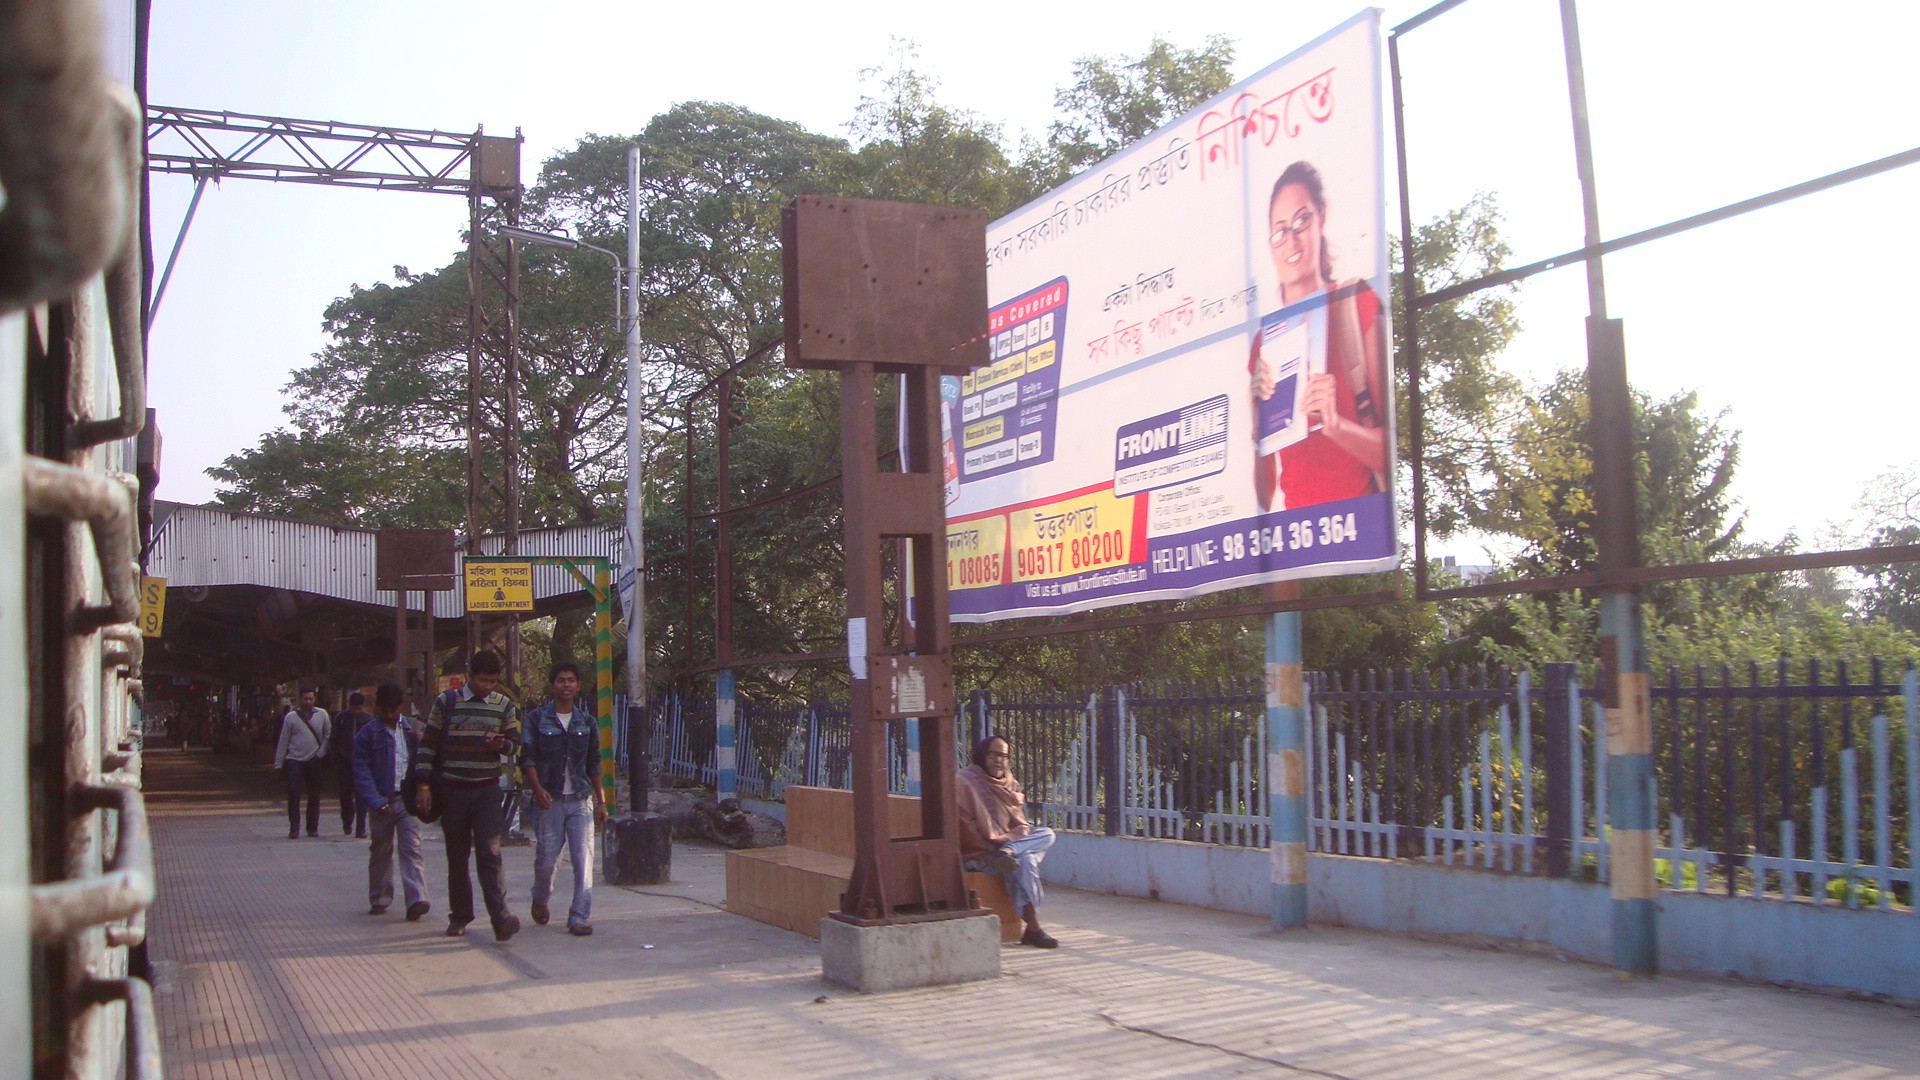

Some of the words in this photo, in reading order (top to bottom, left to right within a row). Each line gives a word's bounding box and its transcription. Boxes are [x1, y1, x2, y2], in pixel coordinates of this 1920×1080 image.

[1017, 200, 1069, 253] সরকারি
[1074, 173, 1131, 226] চাকরির
[1009, 286, 1061, 322] Covered
[1017, 542, 1064, 577] 90517
[1071, 529, 1123, 569] 80200
[1152, 539, 1219, 574] HELPLINE:
[1222, 533, 1245, 562] 98
[1249, 525, 1284, 557] 364
[1288, 519, 1314, 550] 36
[1318, 513, 1358, 546] 364
[959, 553, 1000, 585] 08085
[469, 601, 489, 609] LADIES
[490, 600, 530, 609] COMPARTMENT
[1025, 582, 1041, 598] Visit
